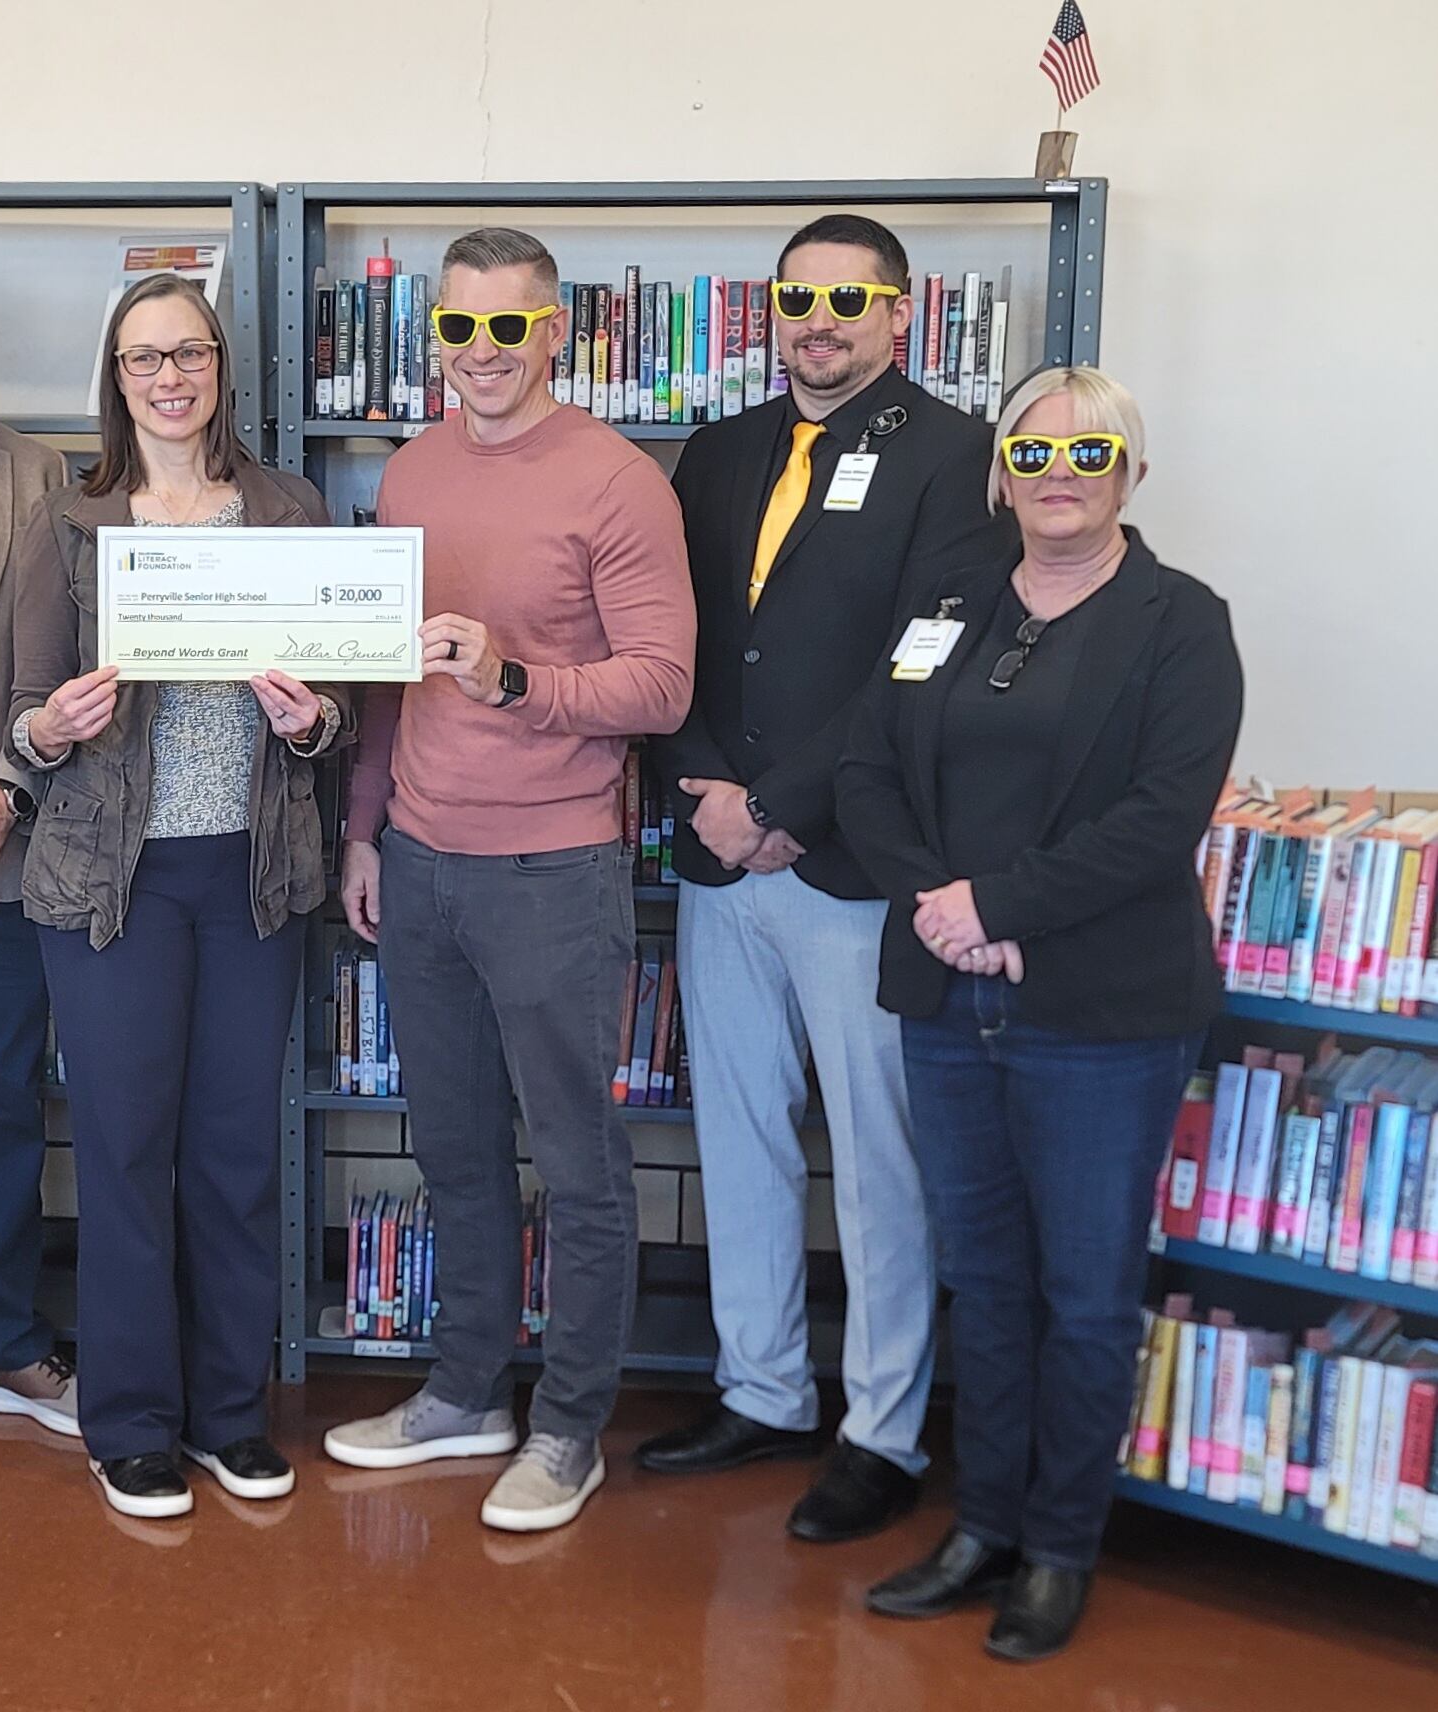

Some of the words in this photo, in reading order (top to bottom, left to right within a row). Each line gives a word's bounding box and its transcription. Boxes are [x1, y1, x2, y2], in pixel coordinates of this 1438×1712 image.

[338, 321, 349, 334] THE
[726, 306, 744, 356] DRY
[338, 335, 349, 364] FALLOUT
[429, 357, 442, 379] GAME
[141, 592, 183, 602] Perryville
[184, 592, 213, 601] Senior
[215, 592, 235, 602] High
[237, 592, 267, 601] School
[320, 586, 332, 605] $
[338, 589, 382, 603] 20,000
[118, 613, 146, 621] Twenty
[147, 613, 183, 621] thousand
[133, 648, 176, 659] Beyond
[178, 648, 215, 657] Words
[217, 648, 248, 657] Grant
[274, 633, 332, 658] Dollar
[337, 640, 407, 665] General
[361, 1016, 375, 1035] 57
